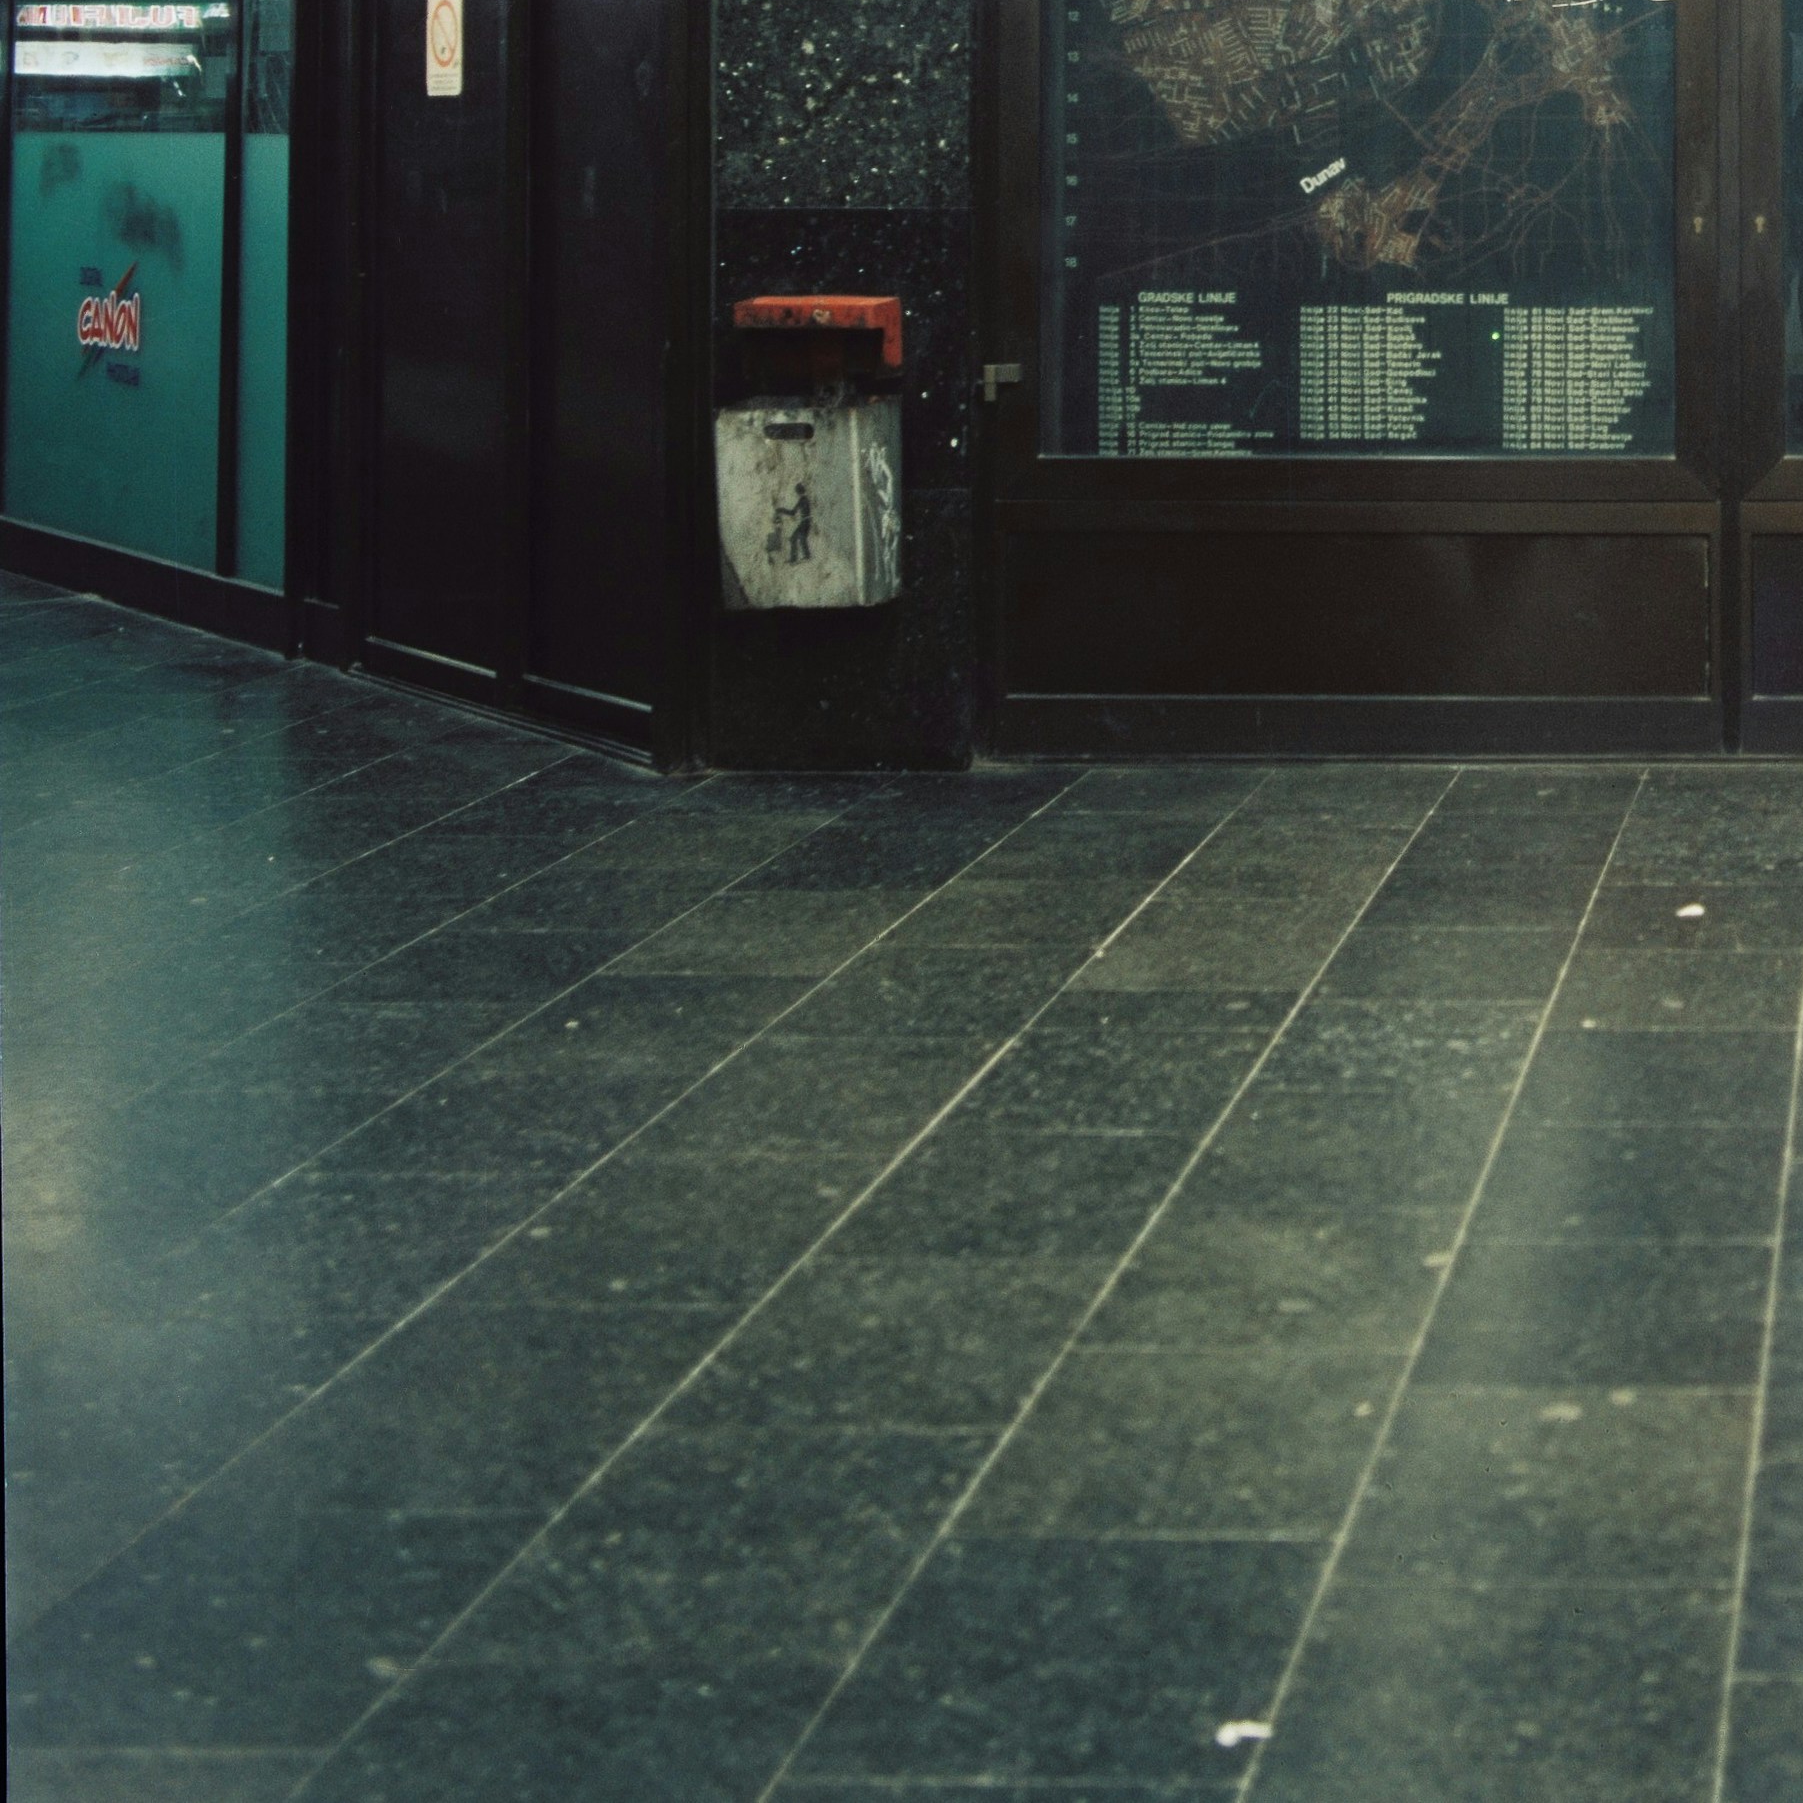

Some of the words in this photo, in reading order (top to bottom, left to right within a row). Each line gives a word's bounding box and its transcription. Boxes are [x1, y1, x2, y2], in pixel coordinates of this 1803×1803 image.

[1066, 10, 1080, 22] 12
[1066, 51, 1080, 63] 13
[1299, 157, 1347, 194] Dunav
[1138, 291, 1194, 304] GRADSKE
[1198, 291, 1236, 304] LINIJE
[1387, 291, 1465, 305] PRIGRADSKE
[1470, 292, 1509, 305] LINIJE
[78, 290, 141, 352] CANON
